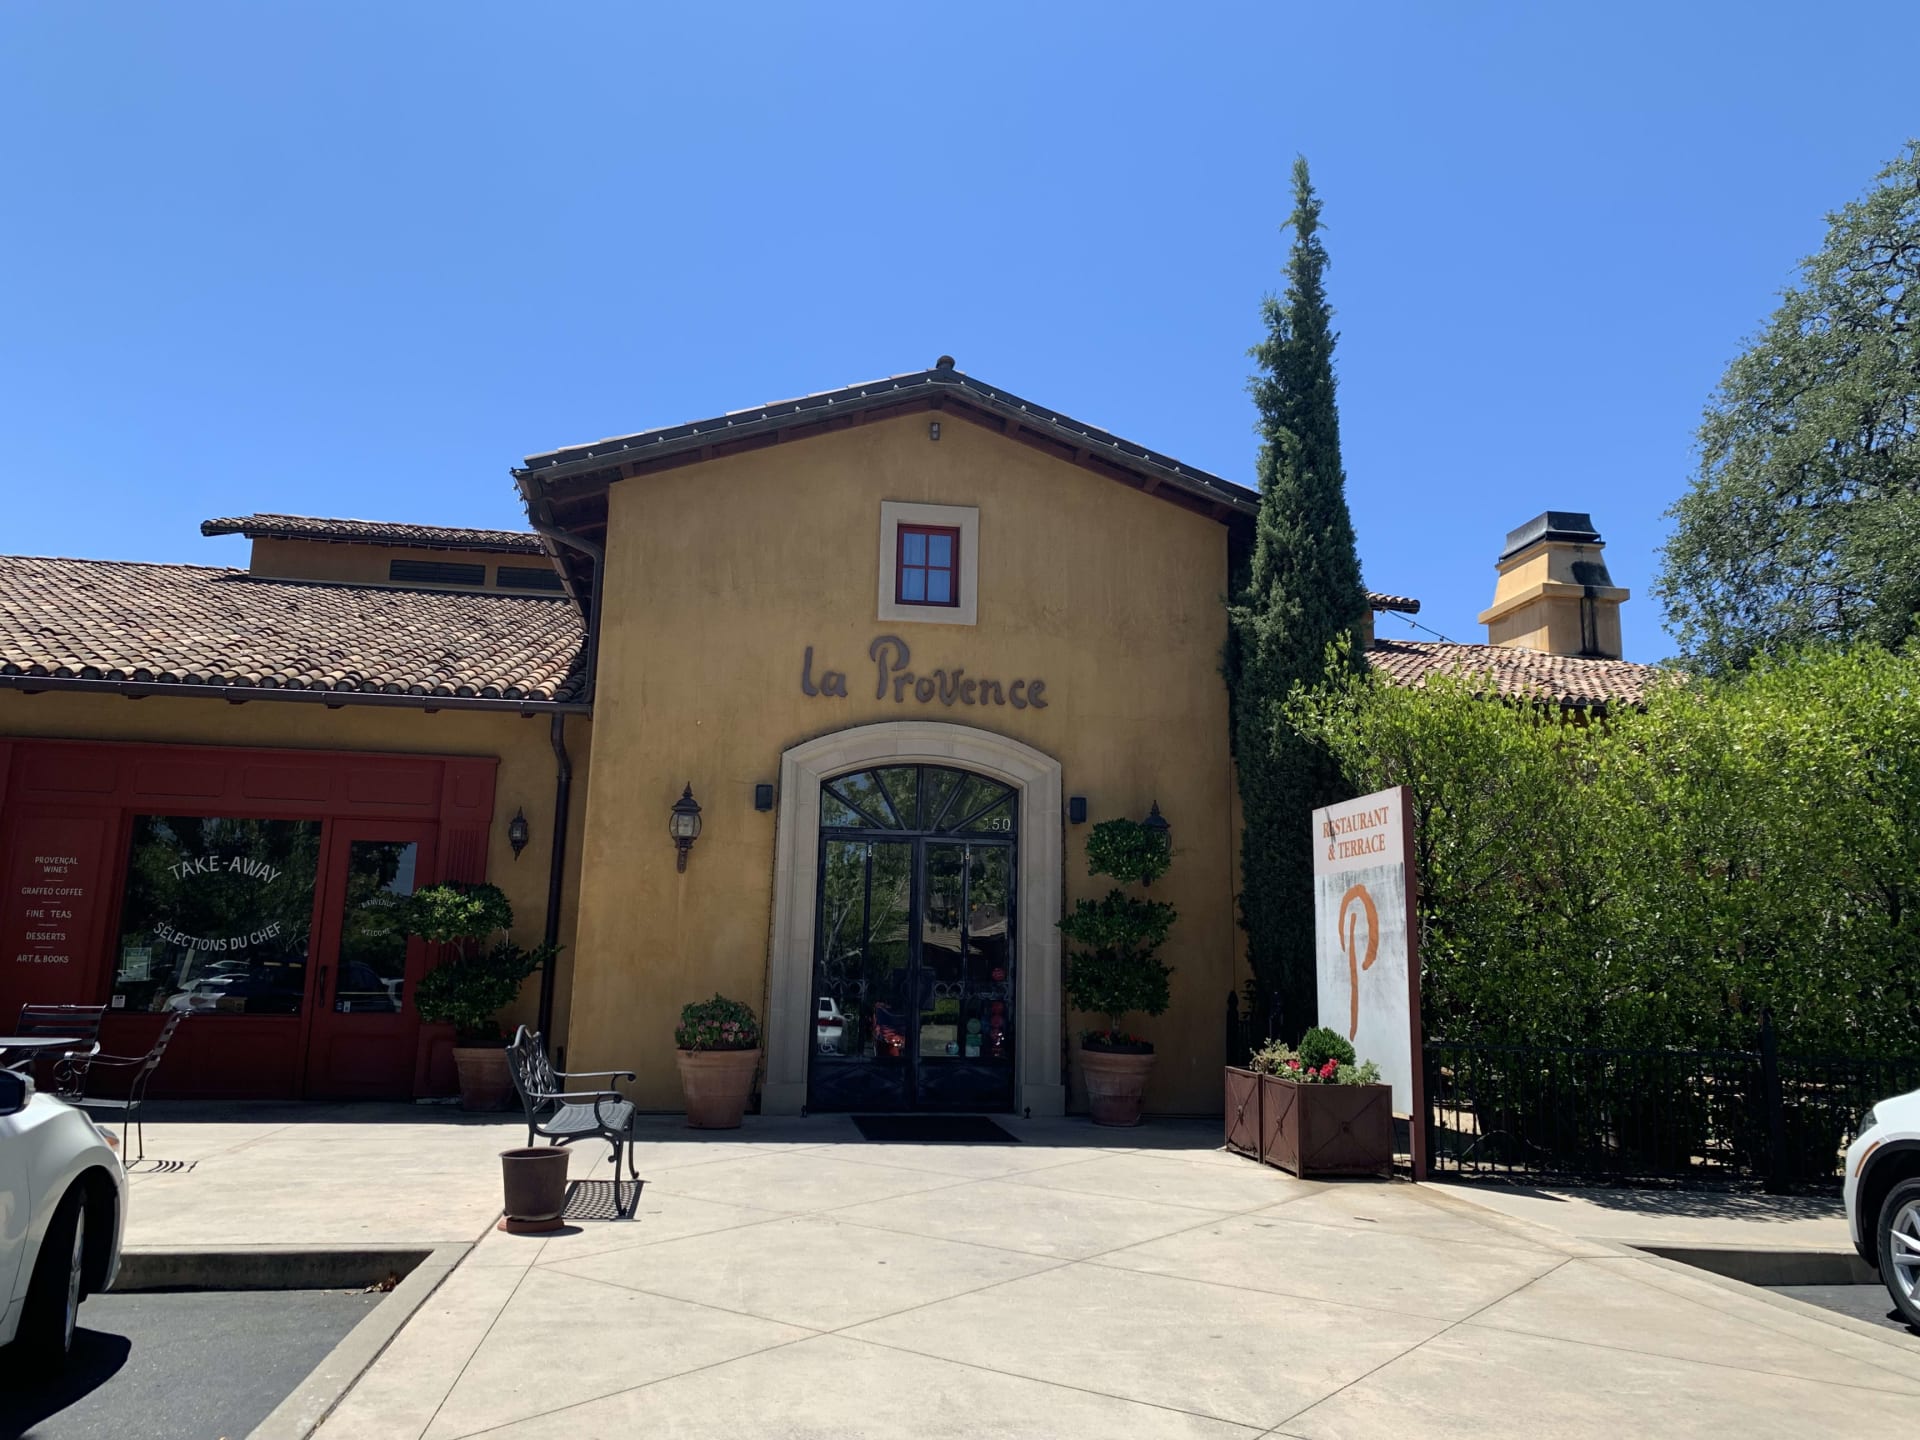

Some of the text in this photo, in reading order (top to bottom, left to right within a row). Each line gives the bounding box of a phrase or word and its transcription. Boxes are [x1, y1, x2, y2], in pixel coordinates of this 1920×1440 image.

[983, 817, 1011, 831] 150
[1322, 806, 1389, 838] RESTAURANT
[1328, 834, 1386, 861] & TERRACE
[43, 866, 68, 874] WINES
[167, 855, 282, 884] TAKE-AWAY
[21, 887, 83, 896] GRAFFEO COFFEE
[26, 909, 72, 919] FINE TEAS
[26, 932, 66, 941] DESSERTS
[230, 936, 248, 950] DU
[250, 921, 282, 945] CHEF
[16, 954, 69, 964] ART & BOOKS
